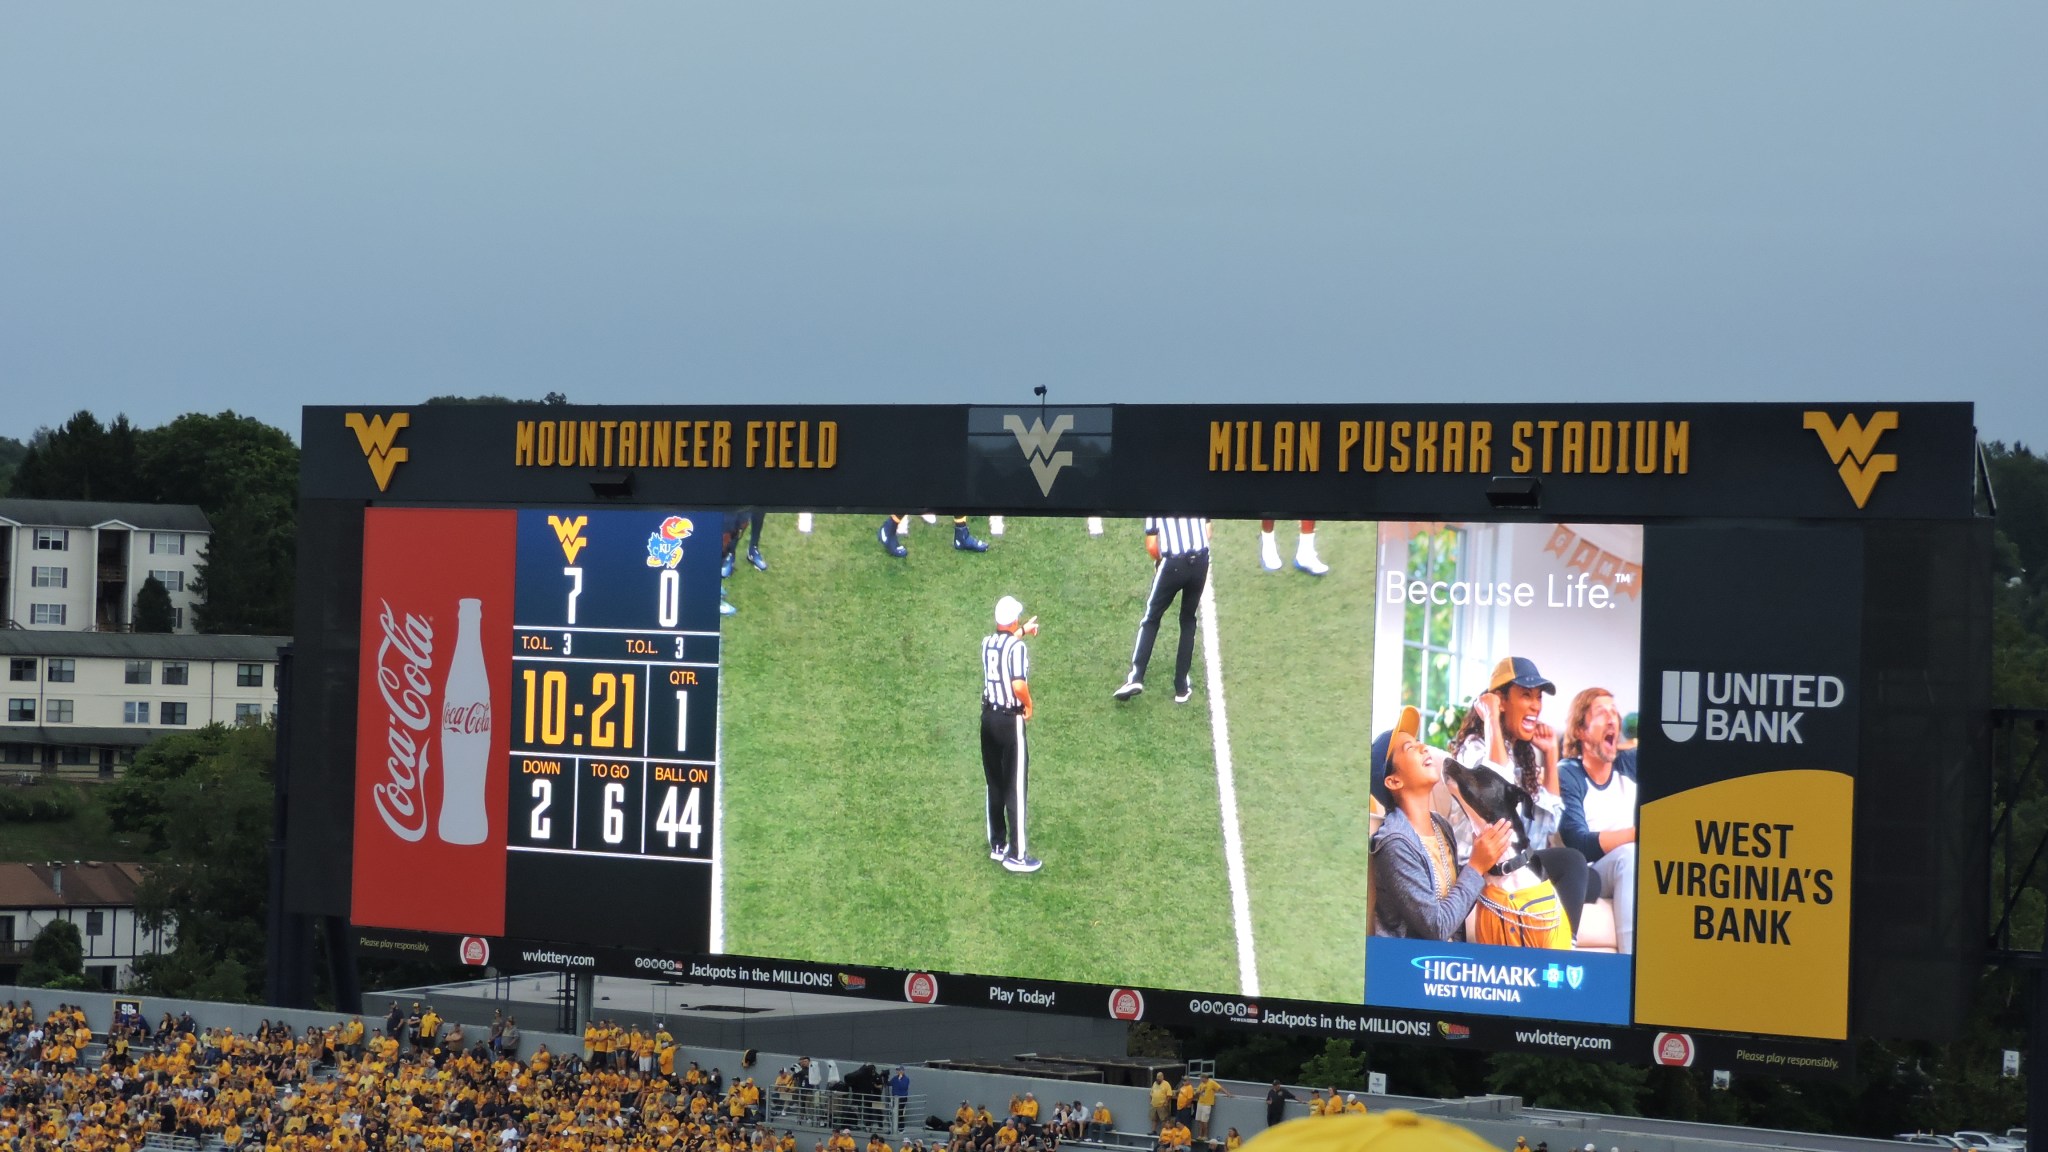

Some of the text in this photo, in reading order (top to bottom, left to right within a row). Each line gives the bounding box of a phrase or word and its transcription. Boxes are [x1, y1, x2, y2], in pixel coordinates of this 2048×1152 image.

[515, 420, 838, 469] MOUNTAINEER FIELD
[1208, 420, 1691, 475] MILAN PUSKAR STADIUM
[660, 543, 671, 554] KU
[564, 567, 583, 625] 7
[658, 569, 680, 628] 0
[1385, 570, 1535, 608] Because
[521, 633, 572, 655] T.O.L. 3
[626, 637, 684, 659] T.O.L. 3
[669, 671, 699, 686] QTR.
[1707, 671, 1845, 708] UNITED
[373, 597, 434, 842] Coca-Cola
[523, 669, 635, 749] 10:21
[676, 690, 688, 751] 1
[1705, 708, 1805, 744] BANK
[523, 760, 561, 776] DOWN
[591, 763, 630, 779] TO GO
[655, 767, 708, 783] BALL ON
[530, 779, 552, 839] 2
[603, 783, 625, 844] 6
[655, 786, 702, 849] 44
[1695, 819, 1794, 859] WEST
[1653, 860, 1834, 905] VIRGINIA'S
[1693, 904, 1792, 946] BANK
[360, 937, 379, 947] Please
[380, 939, 393, 950] play
[522, 949, 595, 967] wvlottery.com
[689, 963, 737, 980] Jackpots
[739, 969, 749, 980] in
[752, 969, 770, 982] the
[772, 970, 833, 987] MILLIONS!
[1424, 960, 1537, 987] HIGHMARK
[990, 986, 1056, 1007] Play Today!
[1424, 982, 1521, 1003] WEST VIRGINIA
[1262, 1009, 1317, 1029] Jackpots
[1320, 1015, 1332, 1028] in
[1335, 1015, 1357, 1030] the
[1360, 1017, 1431, 1037] MILLIONS!
[1515, 1028, 1611, 1050] wvlottery.com
[1736, 1050, 1839, 1071] Please play responsibly.
